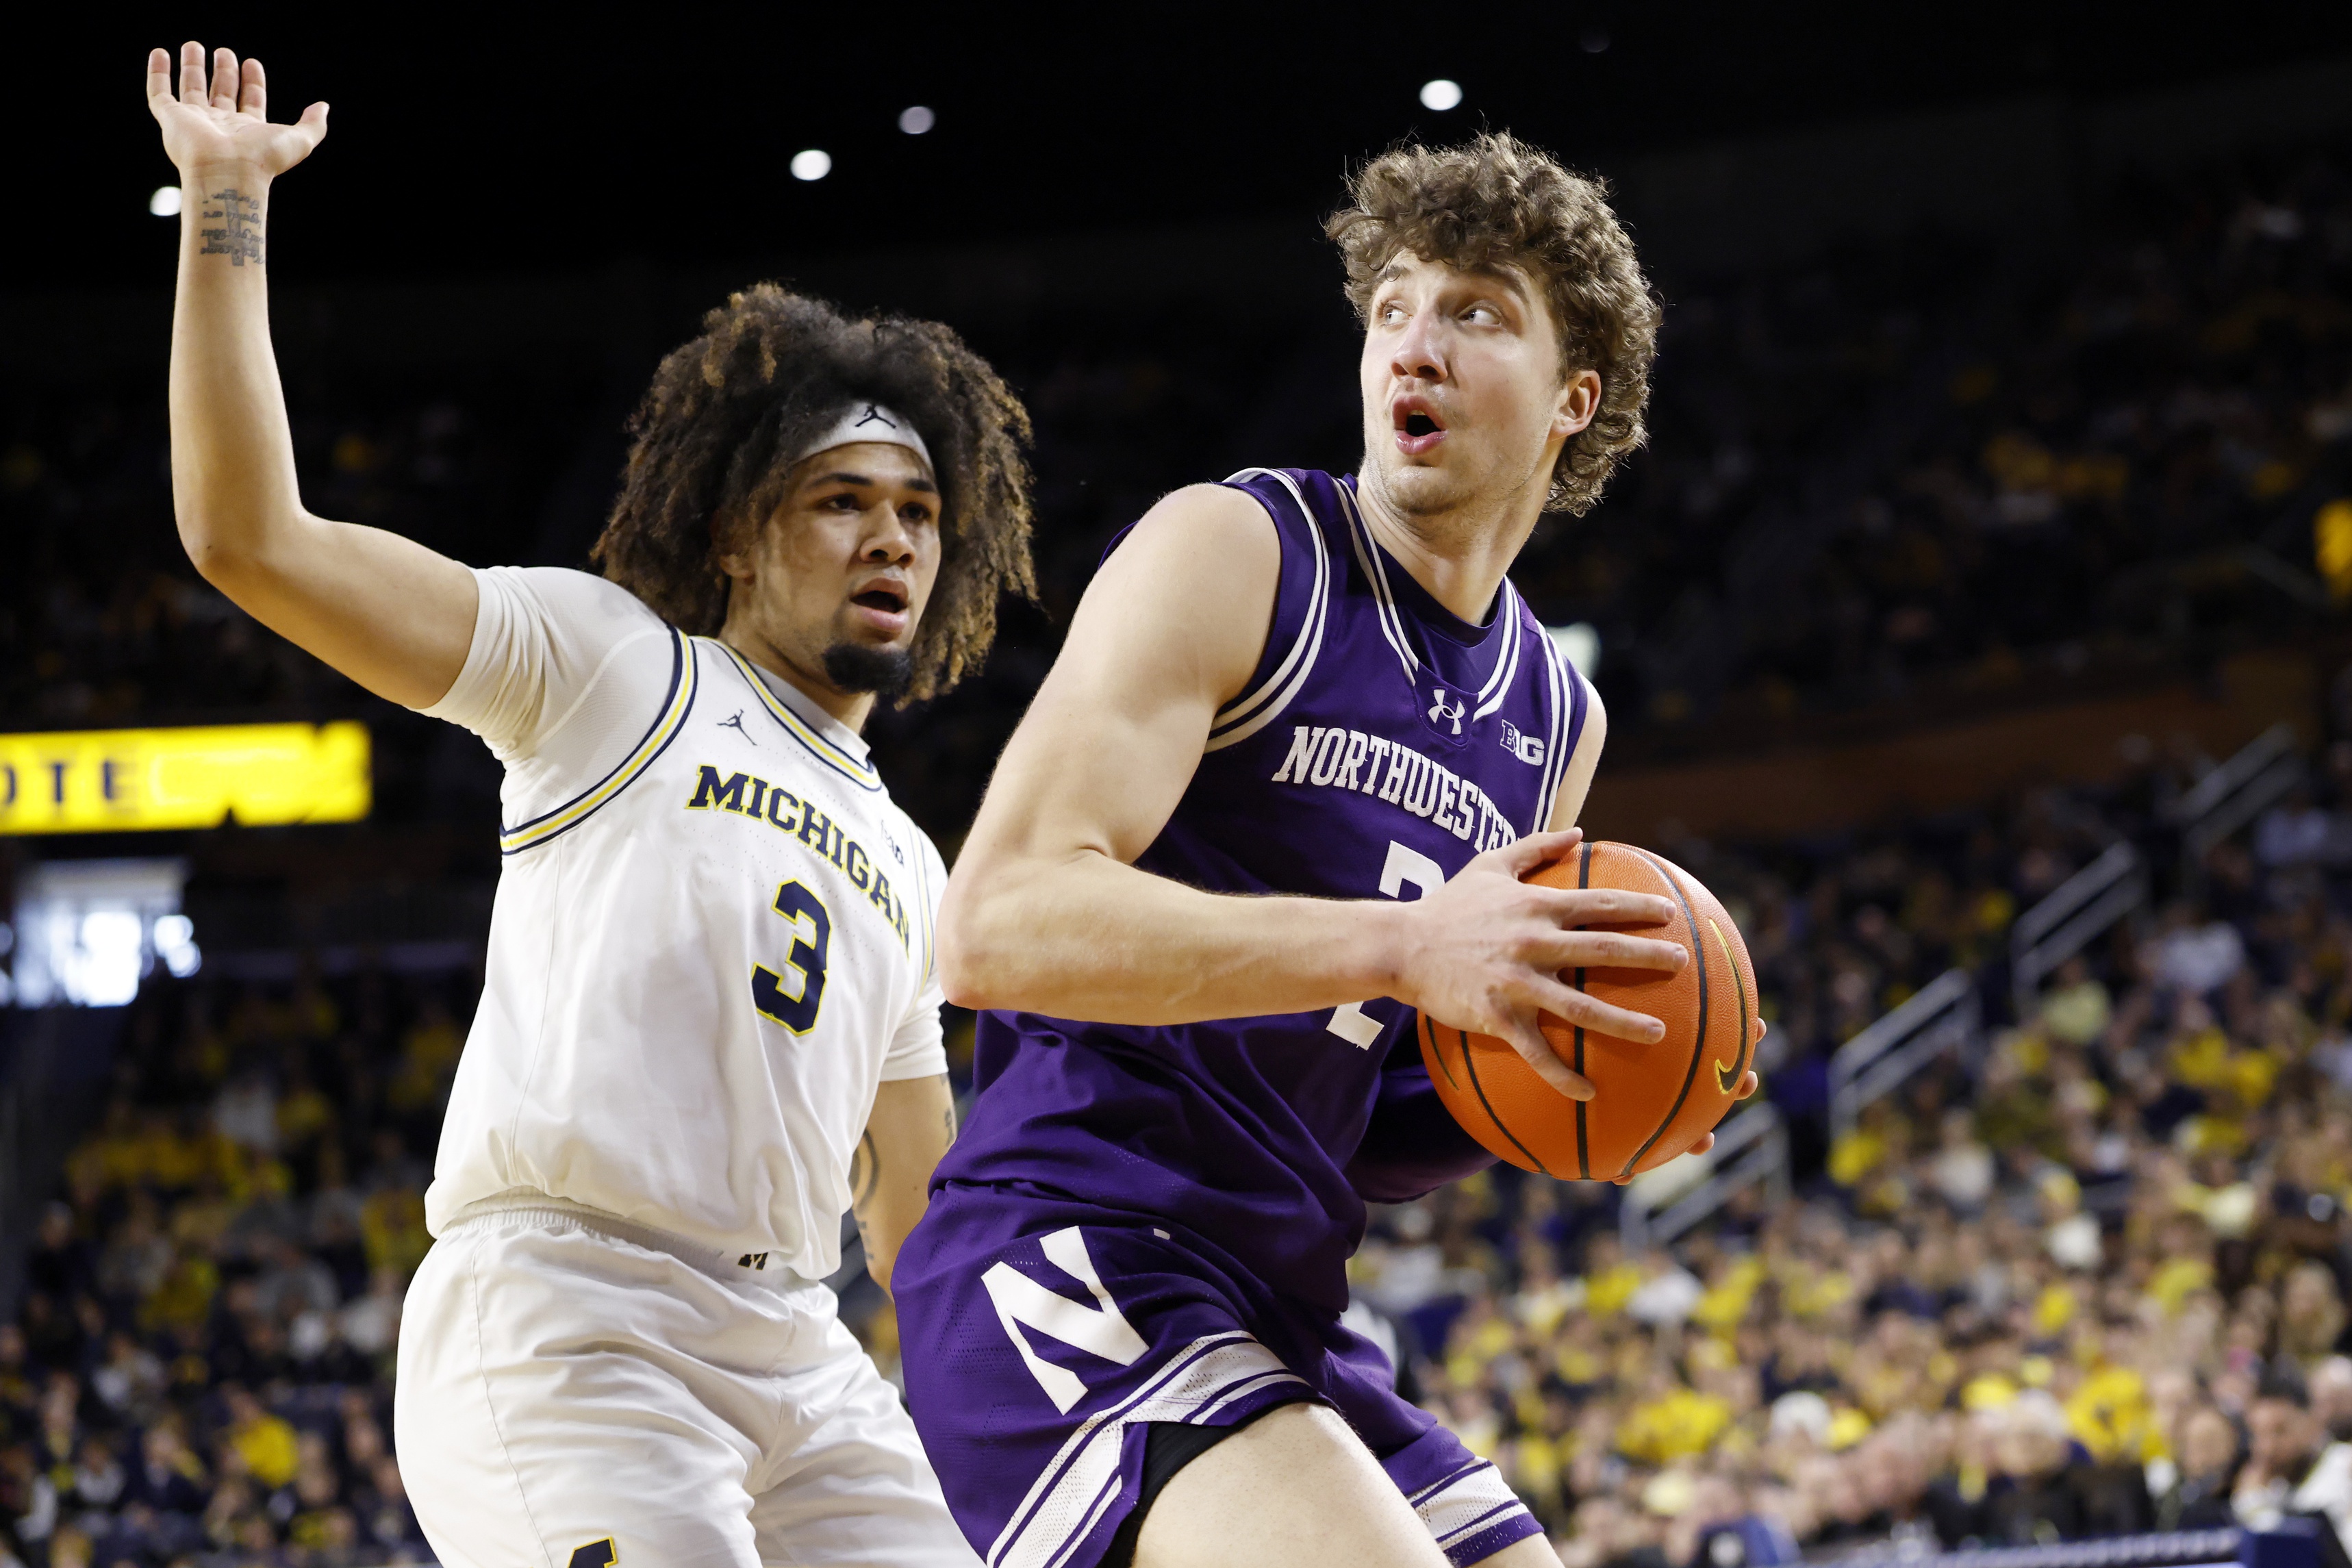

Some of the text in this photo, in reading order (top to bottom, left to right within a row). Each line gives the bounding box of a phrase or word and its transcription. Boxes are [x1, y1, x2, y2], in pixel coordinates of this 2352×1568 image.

[684, 765, 911, 960] MICHIGAN
[751, 876, 833, 1037] 3
[981, 1225, 1150, 1416] N
